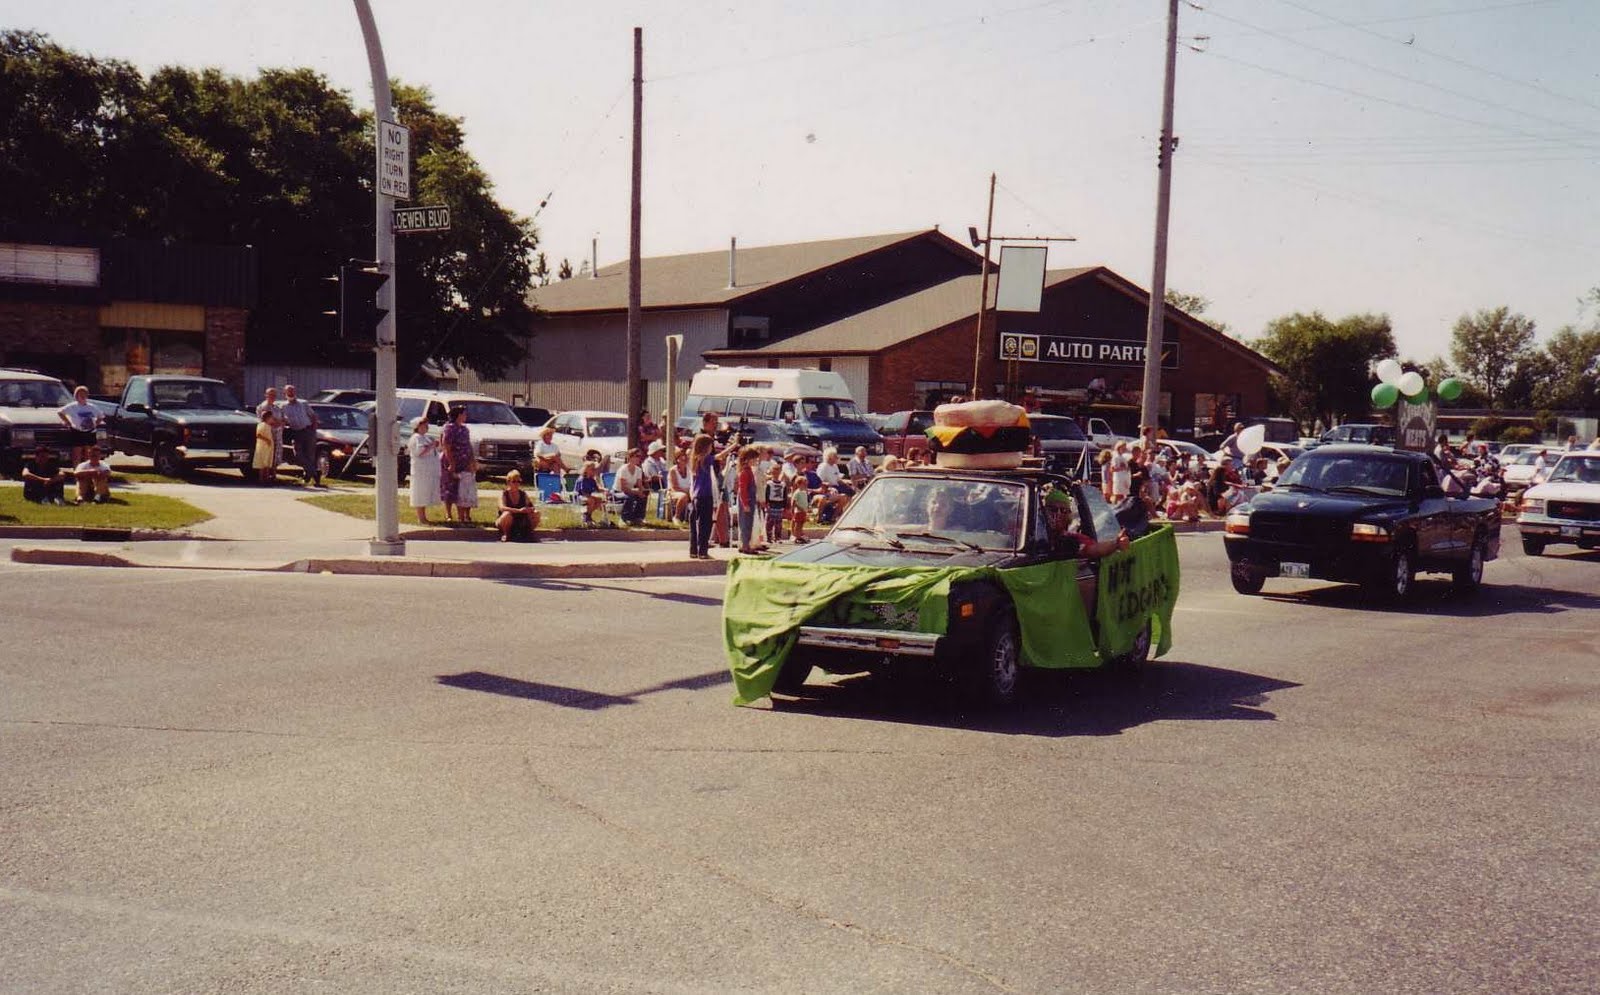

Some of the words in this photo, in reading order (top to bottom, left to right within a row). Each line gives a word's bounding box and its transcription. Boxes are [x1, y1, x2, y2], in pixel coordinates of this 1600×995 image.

[388, 129, 401, 145] NO
[384, 147, 404, 162] RIGHT
[385, 163, 403, 177] TURN
[381, 177, 391, 190] ON
[393, 180, 407, 194] RED
[428, 209, 449, 227] BLVD
[1046, 341, 1093, 359] AUTO
